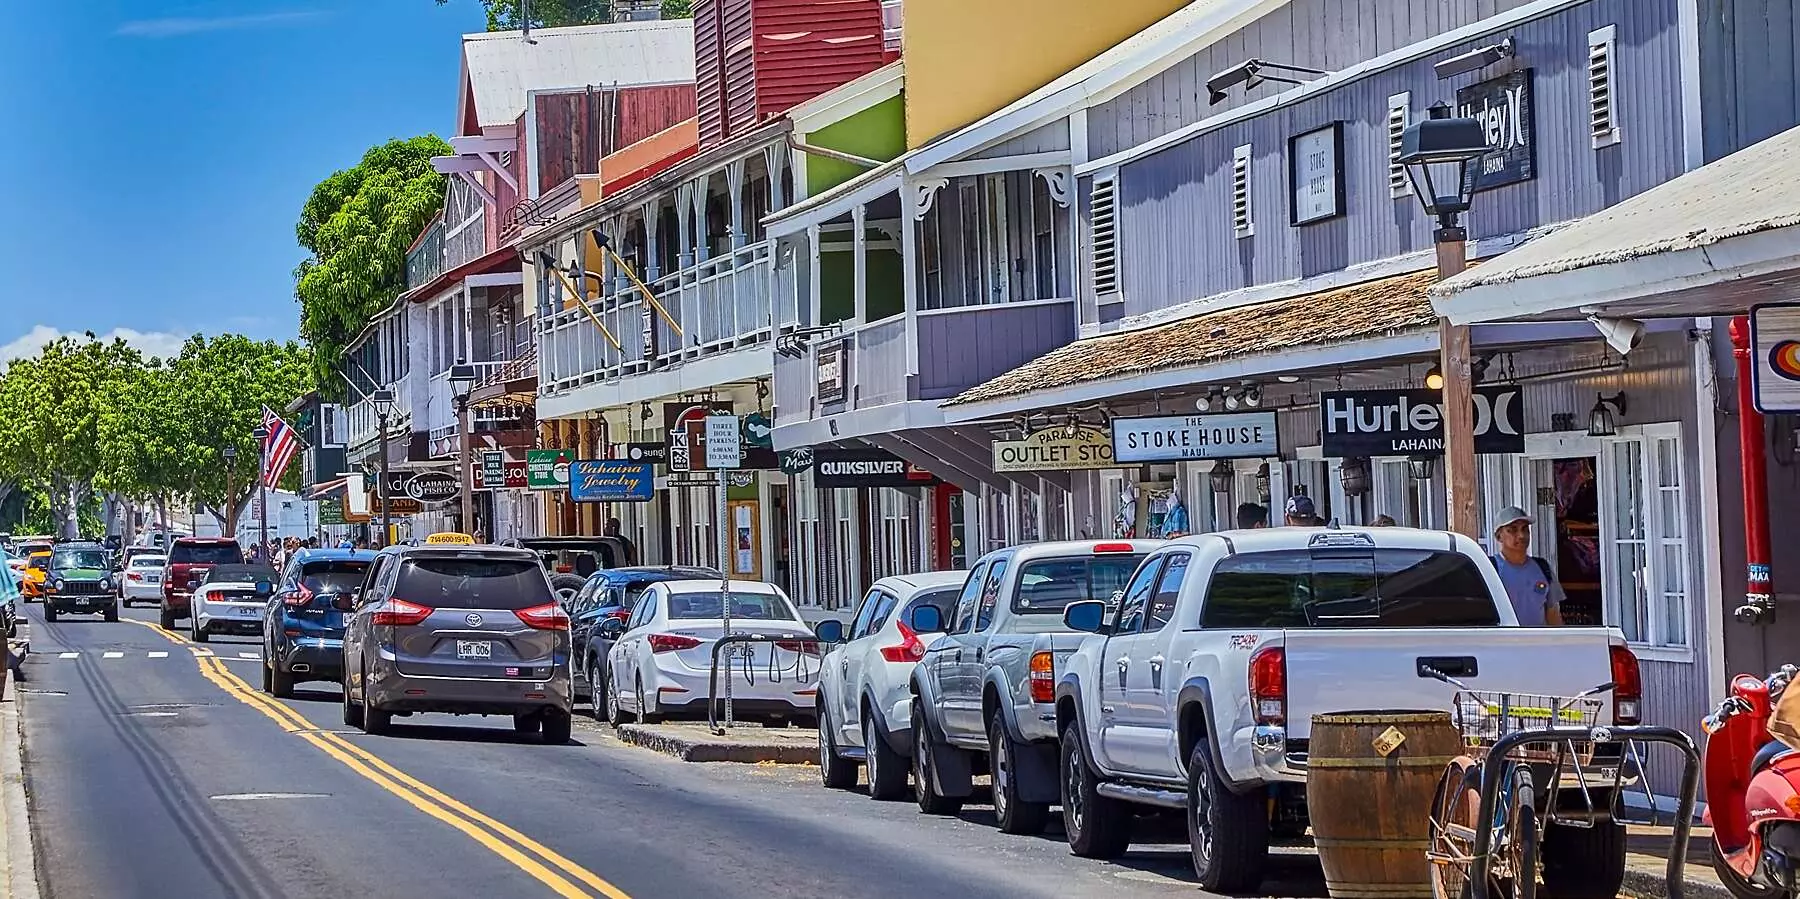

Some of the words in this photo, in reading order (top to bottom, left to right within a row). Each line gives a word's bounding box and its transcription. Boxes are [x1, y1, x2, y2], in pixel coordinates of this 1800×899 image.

[1461, 97, 1507, 149] rley
[1483, 156, 1505, 175] LAHAINA
[1185, 417, 1203, 426] THE
[1327, 396, 1446, 433] Hurle
[1128, 430, 1190, 449] STOKE
[1199, 426, 1263, 446] HOUSE
[643, 448, 665, 458] sungl
[1001, 445, 1070, 463] OUTLET
[1078, 444, 1113, 460] STO
[576, 462, 644, 474] Lahaina
[820, 461, 904, 475] QUIKSILVER
[579, 474, 641, 491] Jewelry
[459, 646, 472, 655] LHR
[474, 646, 489, 656] 006
